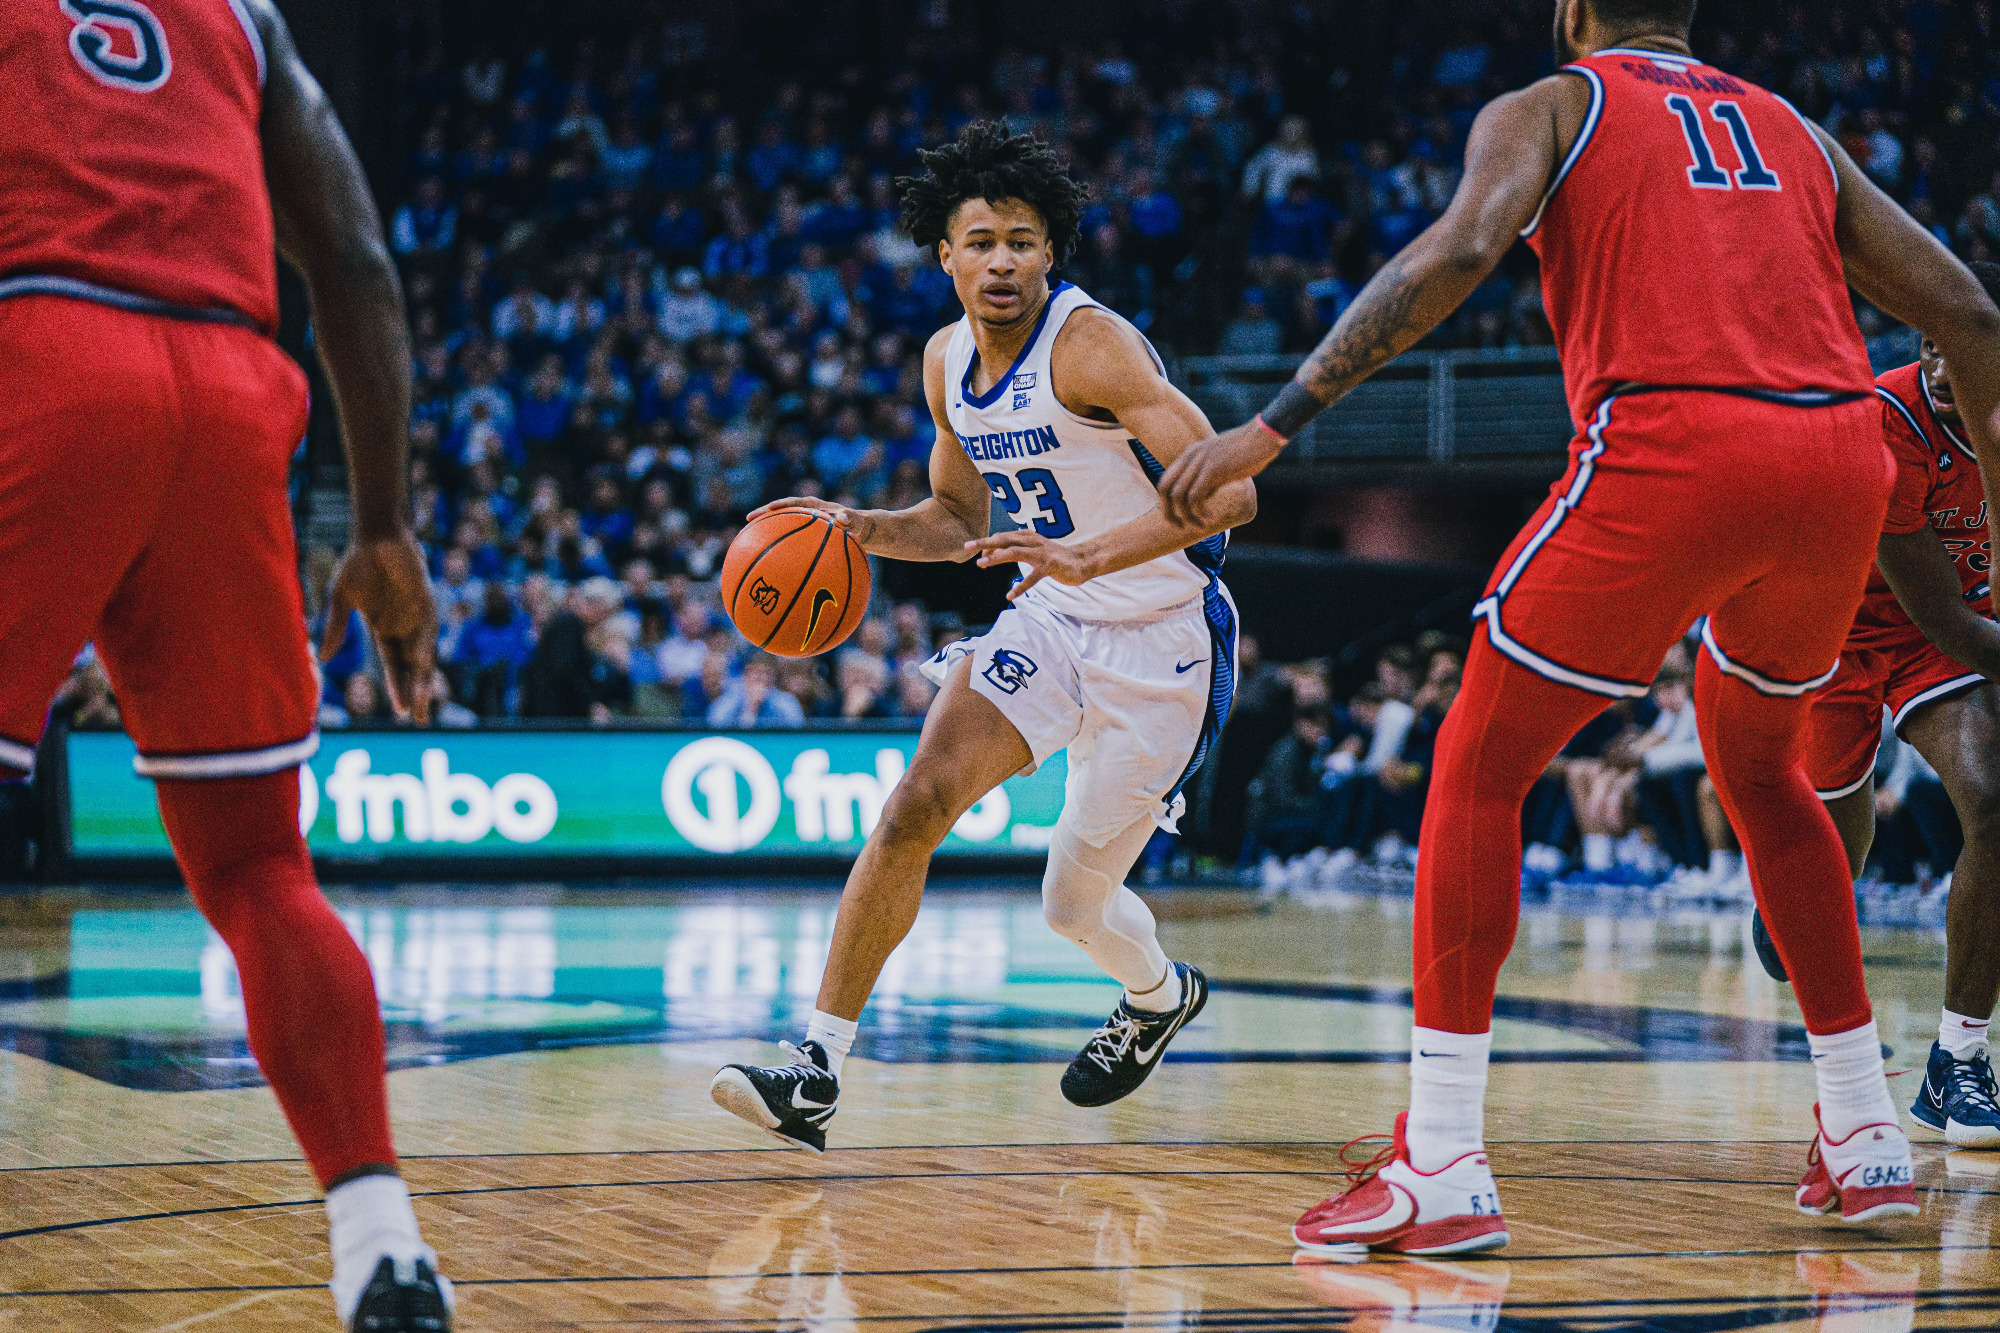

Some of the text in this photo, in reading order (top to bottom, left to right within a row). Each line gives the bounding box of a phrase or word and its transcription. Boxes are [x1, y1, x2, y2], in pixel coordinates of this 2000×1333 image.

[1664, 92, 1782, 192] 11
[1013, 398, 1031, 408] EAST
[1014, 392, 1027, 401] BIG
[955, 425, 1061, 461] REIGHTON
[1938, 453, 1952, 468] JK
[981, 467, 1076, 539] 23
[325, 748, 558, 843] fnbo
